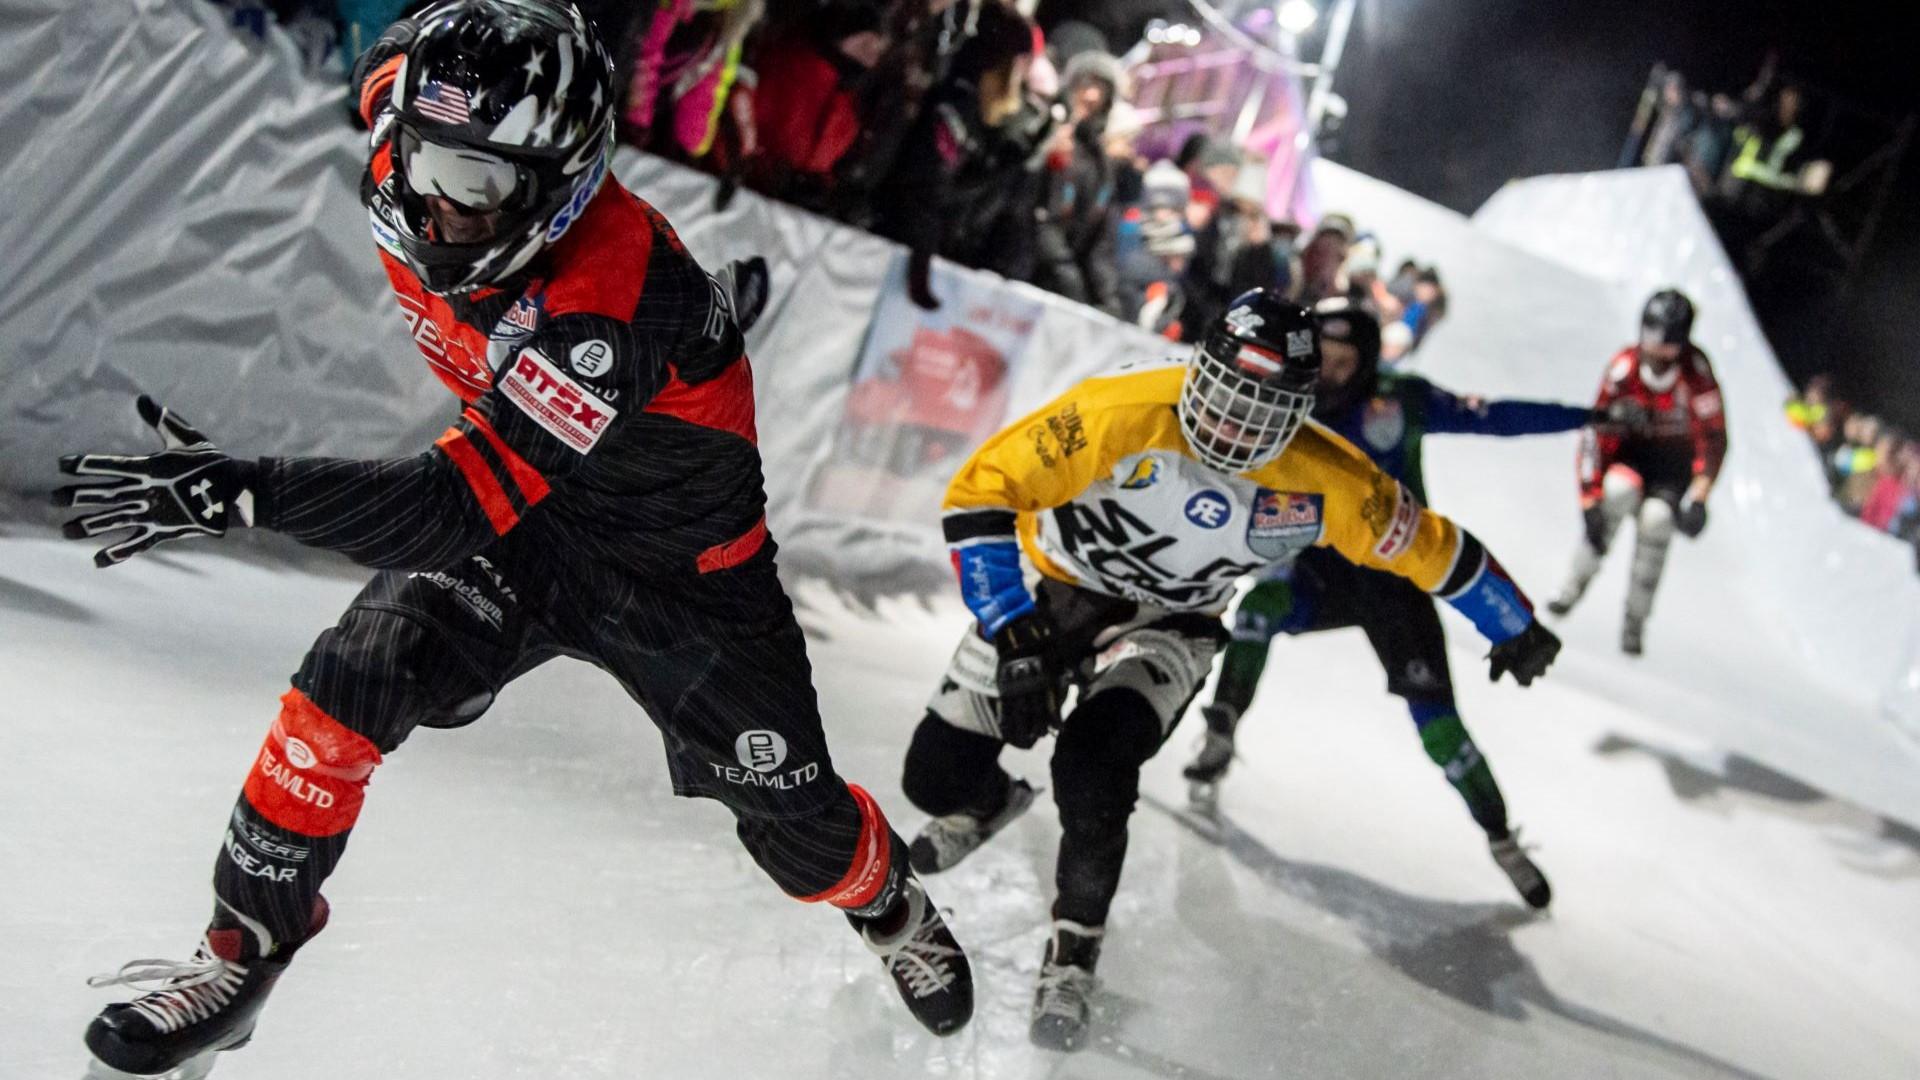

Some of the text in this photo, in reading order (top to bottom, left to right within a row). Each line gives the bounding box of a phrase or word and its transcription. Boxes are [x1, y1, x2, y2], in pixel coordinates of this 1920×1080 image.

[505, 300, 538, 332] Bull
[259, 746, 335, 809] TEAMLTD
[709, 762, 819, 790] TEAMLTD
